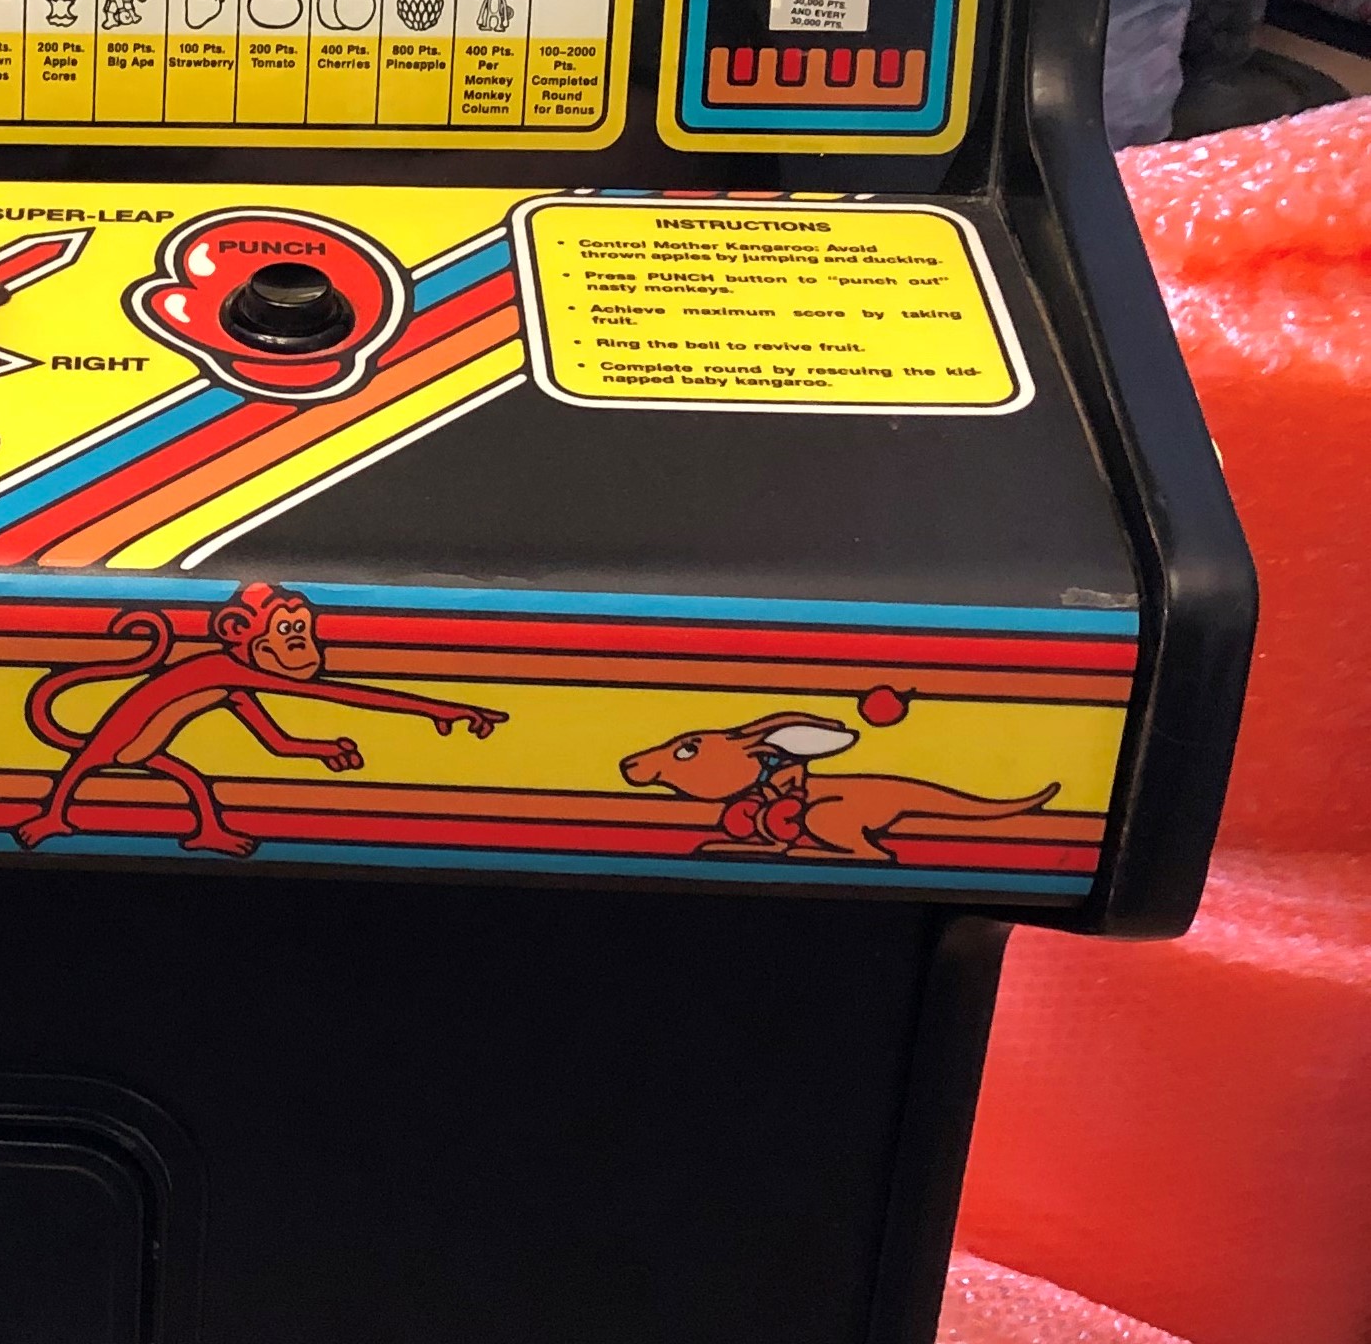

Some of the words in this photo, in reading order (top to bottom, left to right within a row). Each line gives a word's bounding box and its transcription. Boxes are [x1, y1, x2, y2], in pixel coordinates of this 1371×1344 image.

[790, 7, 811, 16] AND
[815, 10, 846, 19] EVERY
[37, 42, 59, 53] 200
[63, 43, 84, 53] Pts.
[107, 43, 129, 54] 800
[133, 43, 155, 54] Pts.
[179, 43, 200, 54] 100
[204, 44, 226, 55] Pts.
[249, 44, 271, 55] 200
[275, 44, 298, 55] Pts.
[321, 44, 344, 55] 400
[347, 45, 370, 56] Pts.
[392, 45, 415, 56] 800
[418, 45, 441, 56] Pts.
[465, 46, 488, 57] 400
[492, 46, 514, 57] Pts.
[43, 57, 78, 69] Apple
[107, 57, 127, 69] Big
[131, 57, 155, 69] Ape
[169, 57, 234, 70] Strawberry
[251, 58, 296, 69] Tomato
[317, 58, 371, 70] Cherries
[386, 59, 446, 72] Pineapple
[478, 60, 500, 71] Per
[553, 61, 577, 72] Pts.
[42, 70, 77, 82] Cores
[464, 75, 513, 88] Monkey
[531, 75, 598, 88] Completed
[463, 91, 512, 103] Monkey
[542, 91, 582, 102] Round
[461, 104, 510, 115] Column
[534, 104, 551, 115] for
[556, 104, 595, 116] Bonus
[656, 219, 831, 232] INSTRUCTIONS
[218, 239, 327, 255] PUNCH
[579, 239, 646, 249] Control
[653, 241, 719, 250] Mother
[725, 242, 819, 254] Kangaroo:
[826, 244, 878, 253] Avoid
[581, 250, 646, 259] thrown
[651, 253, 711, 261] apples
[716, 253, 738, 263] by
[742, 253, 819, 264] jumping
[824, 255, 858, 263] and
[862, 256, 944, 266] ducking.
[585, 271, 636, 281] Press
[647, 272, 714, 282] PUNCH
[725, 274, 788, 284] button
[797, 275, 818, 285] to
[587, 284, 637, 293] nasty
[644, 284, 734, 295] monkeys.
[591, 304, 666, 314] Achieve
[682, 306, 776, 317] maximum
[793, 309, 846, 318] score
[862, 309, 885, 320] by
[901, 309, 963, 321] taking
[592, 316, 638, 325] fruit.
[596, 338, 640, 349] Ring
[647, 340, 678, 349] the
[685, 340, 720, 349] bell
[727, 342, 747, 350] to
[753, 342, 812, 352] revive
[819, 343, 866, 353] fruit.
[51, 356, 150, 372] RIGHT
[601, 361, 693, 373] Complete
[704, 364, 762, 375] round
[772, 365, 796, 376] by
[807, 367, 893, 378] rescuing
[903, 367, 936, 377] the
[945, 367, 982, 377] kid-
[603, 375, 674, 384] napped
[682, 376, 728, 386] baby
[735, 377, 834, 388] kangaroo.
